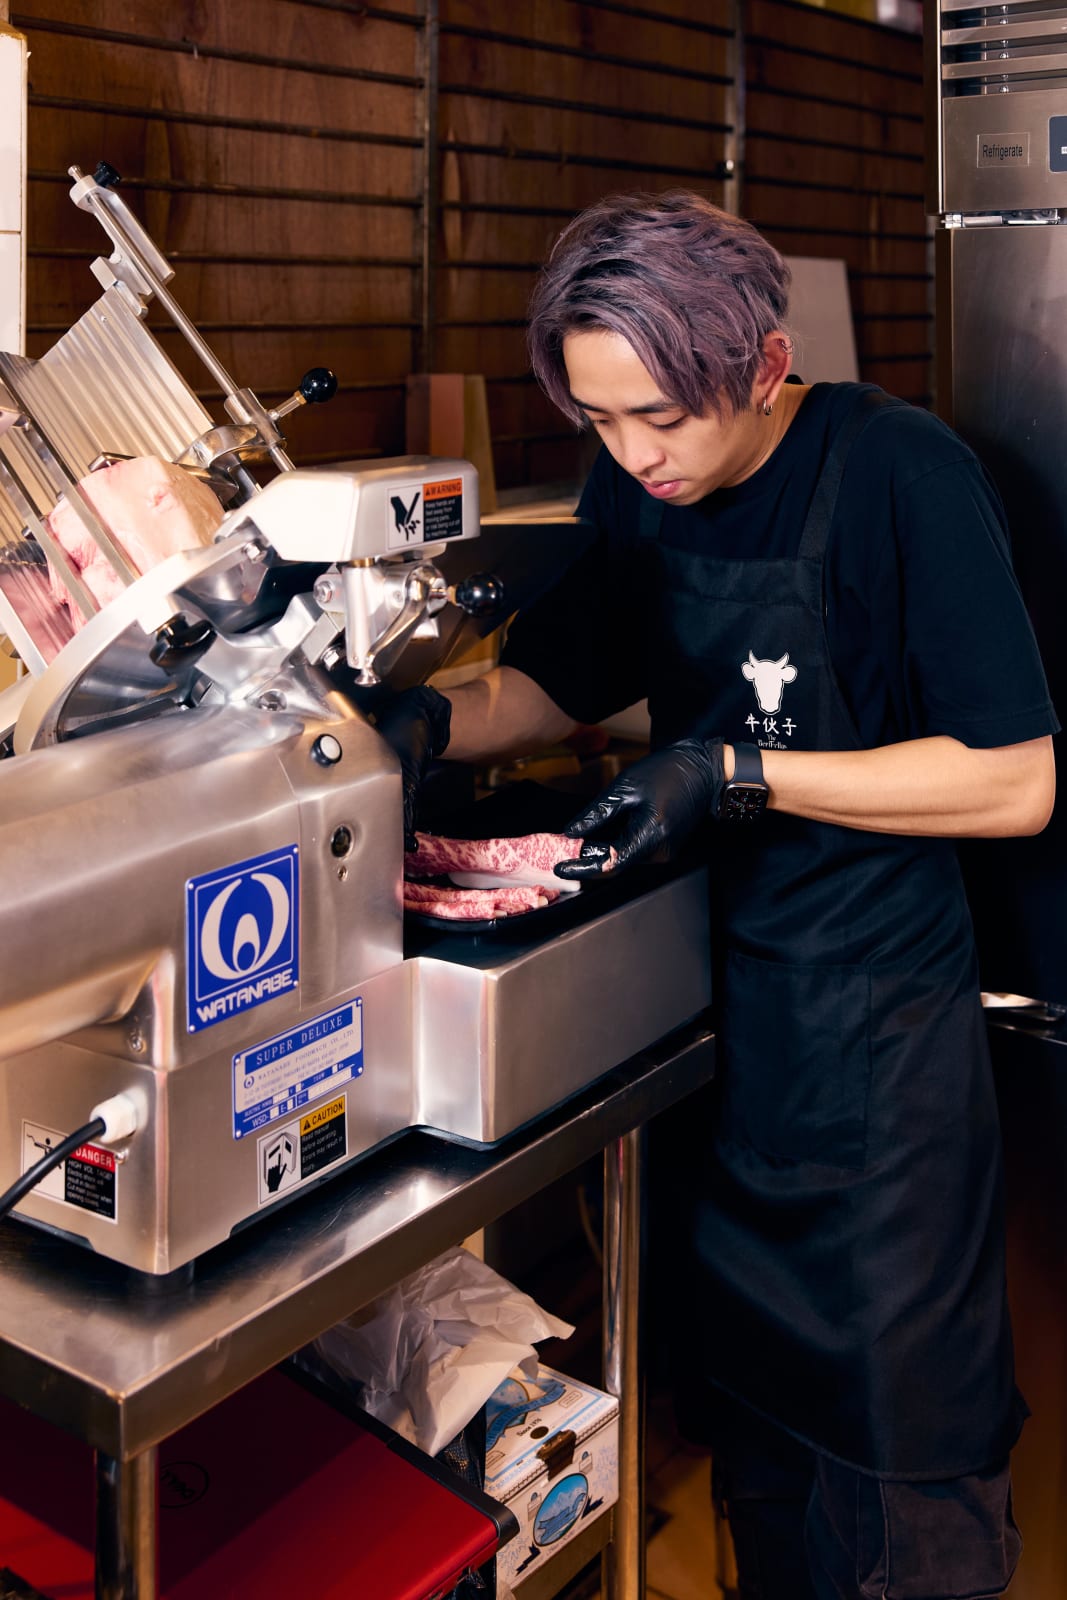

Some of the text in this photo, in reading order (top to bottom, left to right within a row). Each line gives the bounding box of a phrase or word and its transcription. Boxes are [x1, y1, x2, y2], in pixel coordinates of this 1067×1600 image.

[982, 144, 1023, 161] Refrigerate
[430, 480, 461, 496] WARNING
[744, 712, 798, 737] 牛伙子
[196, 967, 294, 1023] WATANABE
[256, 1015, 343, 1066] SUPER DELUXE
[311, 1101, 343, 1125] CAUTION
[75, 1147, 112, 1168] DANGER
